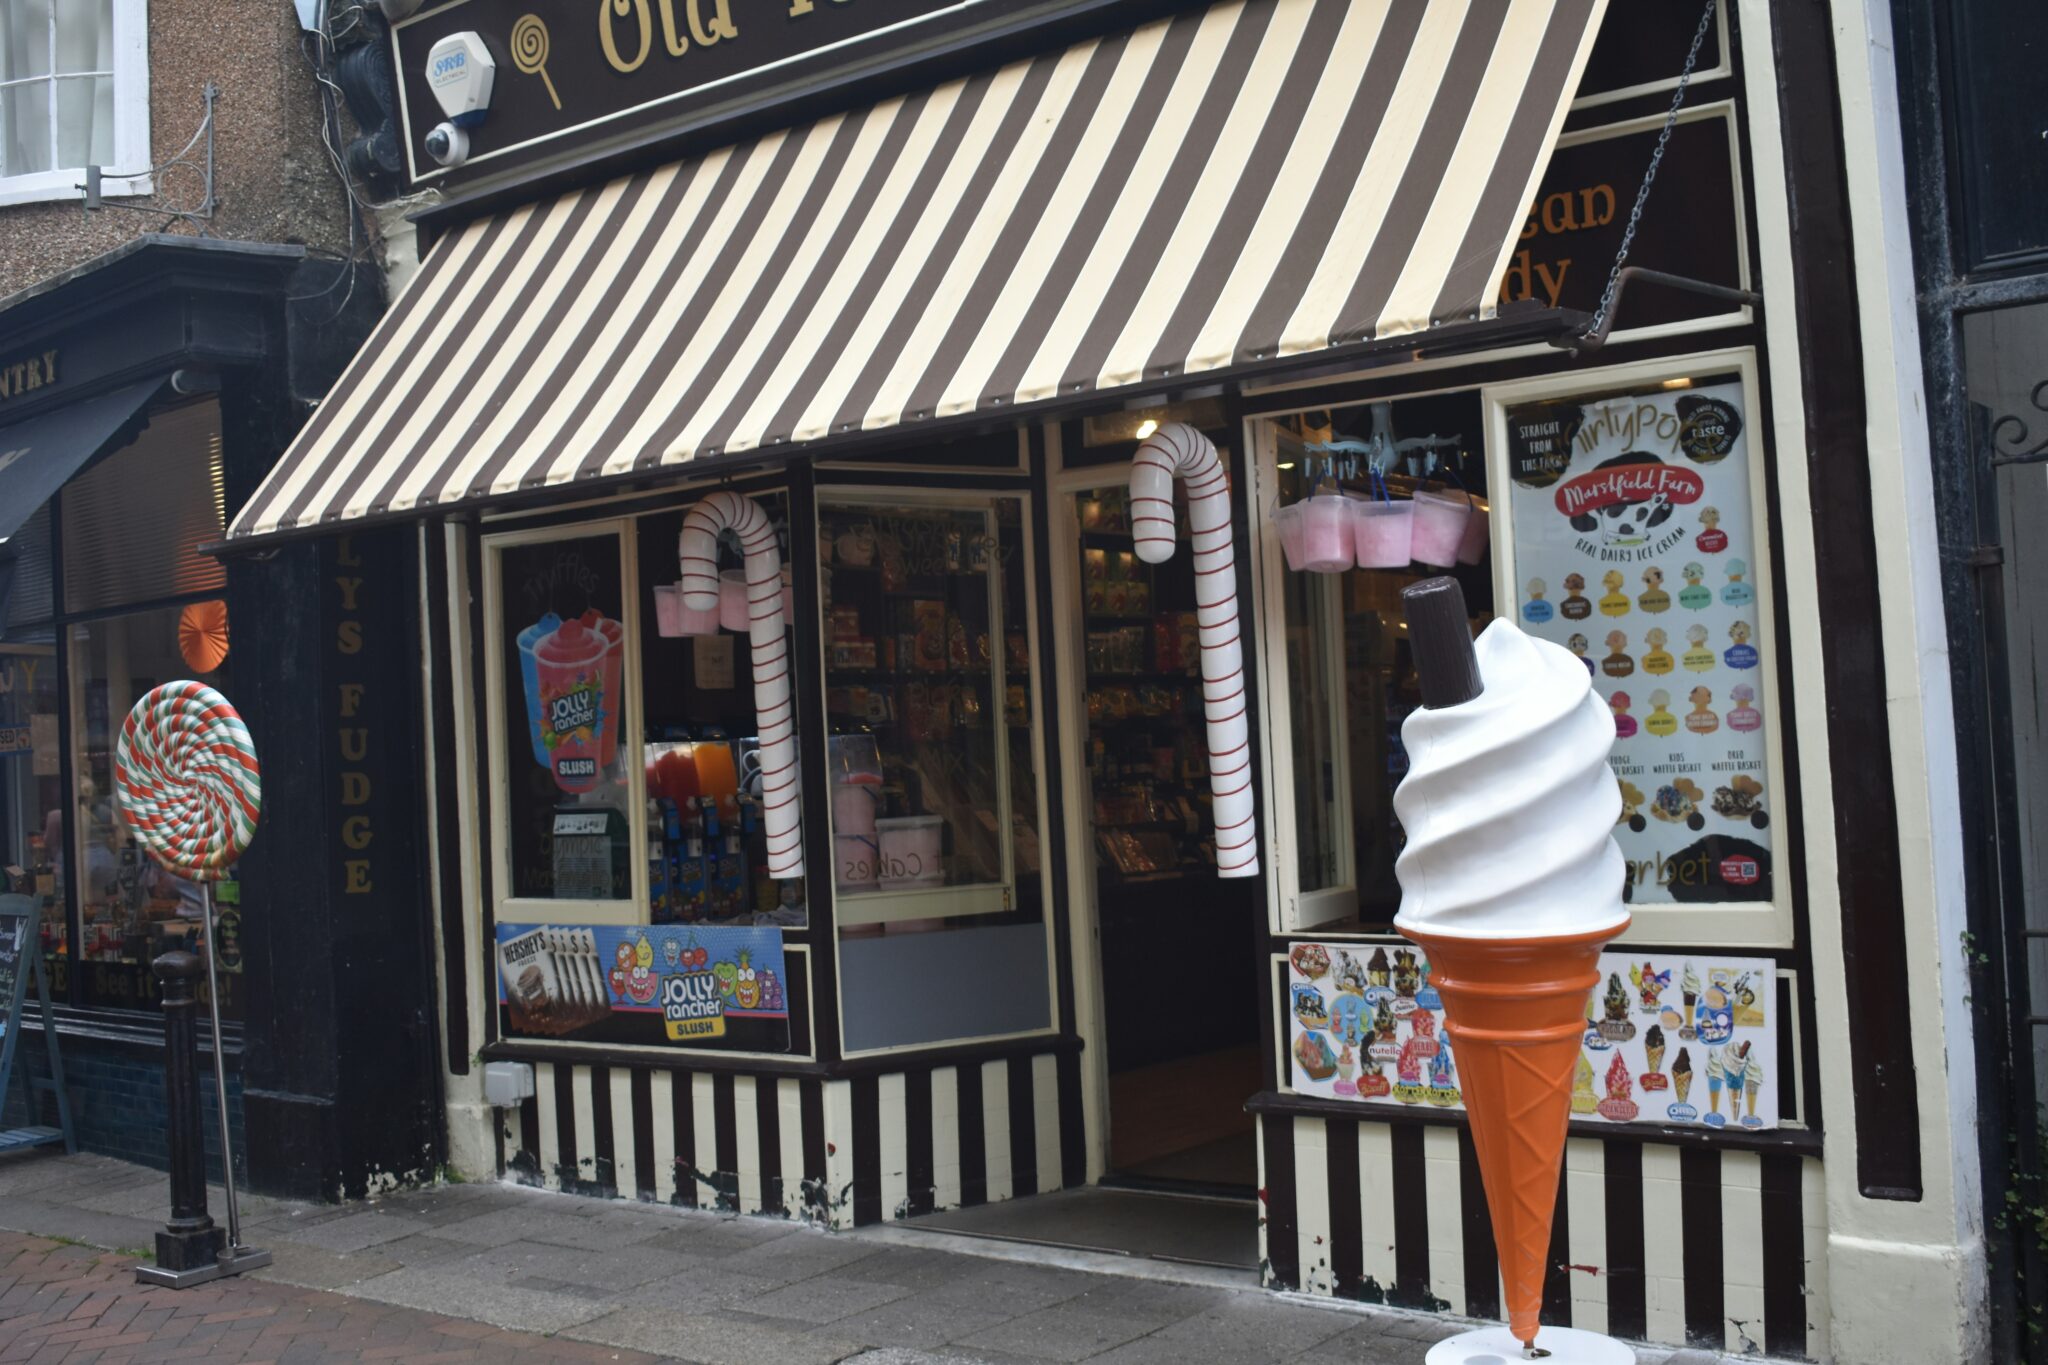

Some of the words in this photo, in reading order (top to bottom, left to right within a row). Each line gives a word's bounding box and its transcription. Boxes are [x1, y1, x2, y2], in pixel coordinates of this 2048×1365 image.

[434, 52, 465, 77] SRB
[1519, 421, 1561, 439] STRAIGHT
[1529, 439, 1552, 455] FROM
[1565, 469, 1655, 513] Marshfield
[1659, 469, 1697, 496] Farm
[1574, 537, 1598, 559] REAL
[1600, 547, 1632, 562] DAIRY
[1637, 547, 1654, 562] ICE
[1656, 526, 1686, 555] CREAM
[552, 689, 590, 721] JOLLY
[554, 706, 594, 731] rancher
[558, 759, 595, 777] SLUSH
[1653, 764, 1676, 774] WAFFLE
[1678, 762, 1702, 773] BASKET
[1668, 752, 1685, 763] KIDS
[1711, 761, 1735, 772] WAFFLE
[1737, 759, 1762, 771] BASKET
[339, 683, 374, 894] FUDGE
[503, 931, 547, 965] HERSHEY'S
[662, 973, 716, 1005] JOLLY
[666, 997, 721, 1020] rancher
[677, 1021, 714, 1035] SLUSH
[1369, 1046, 1402, 1055] nutella
